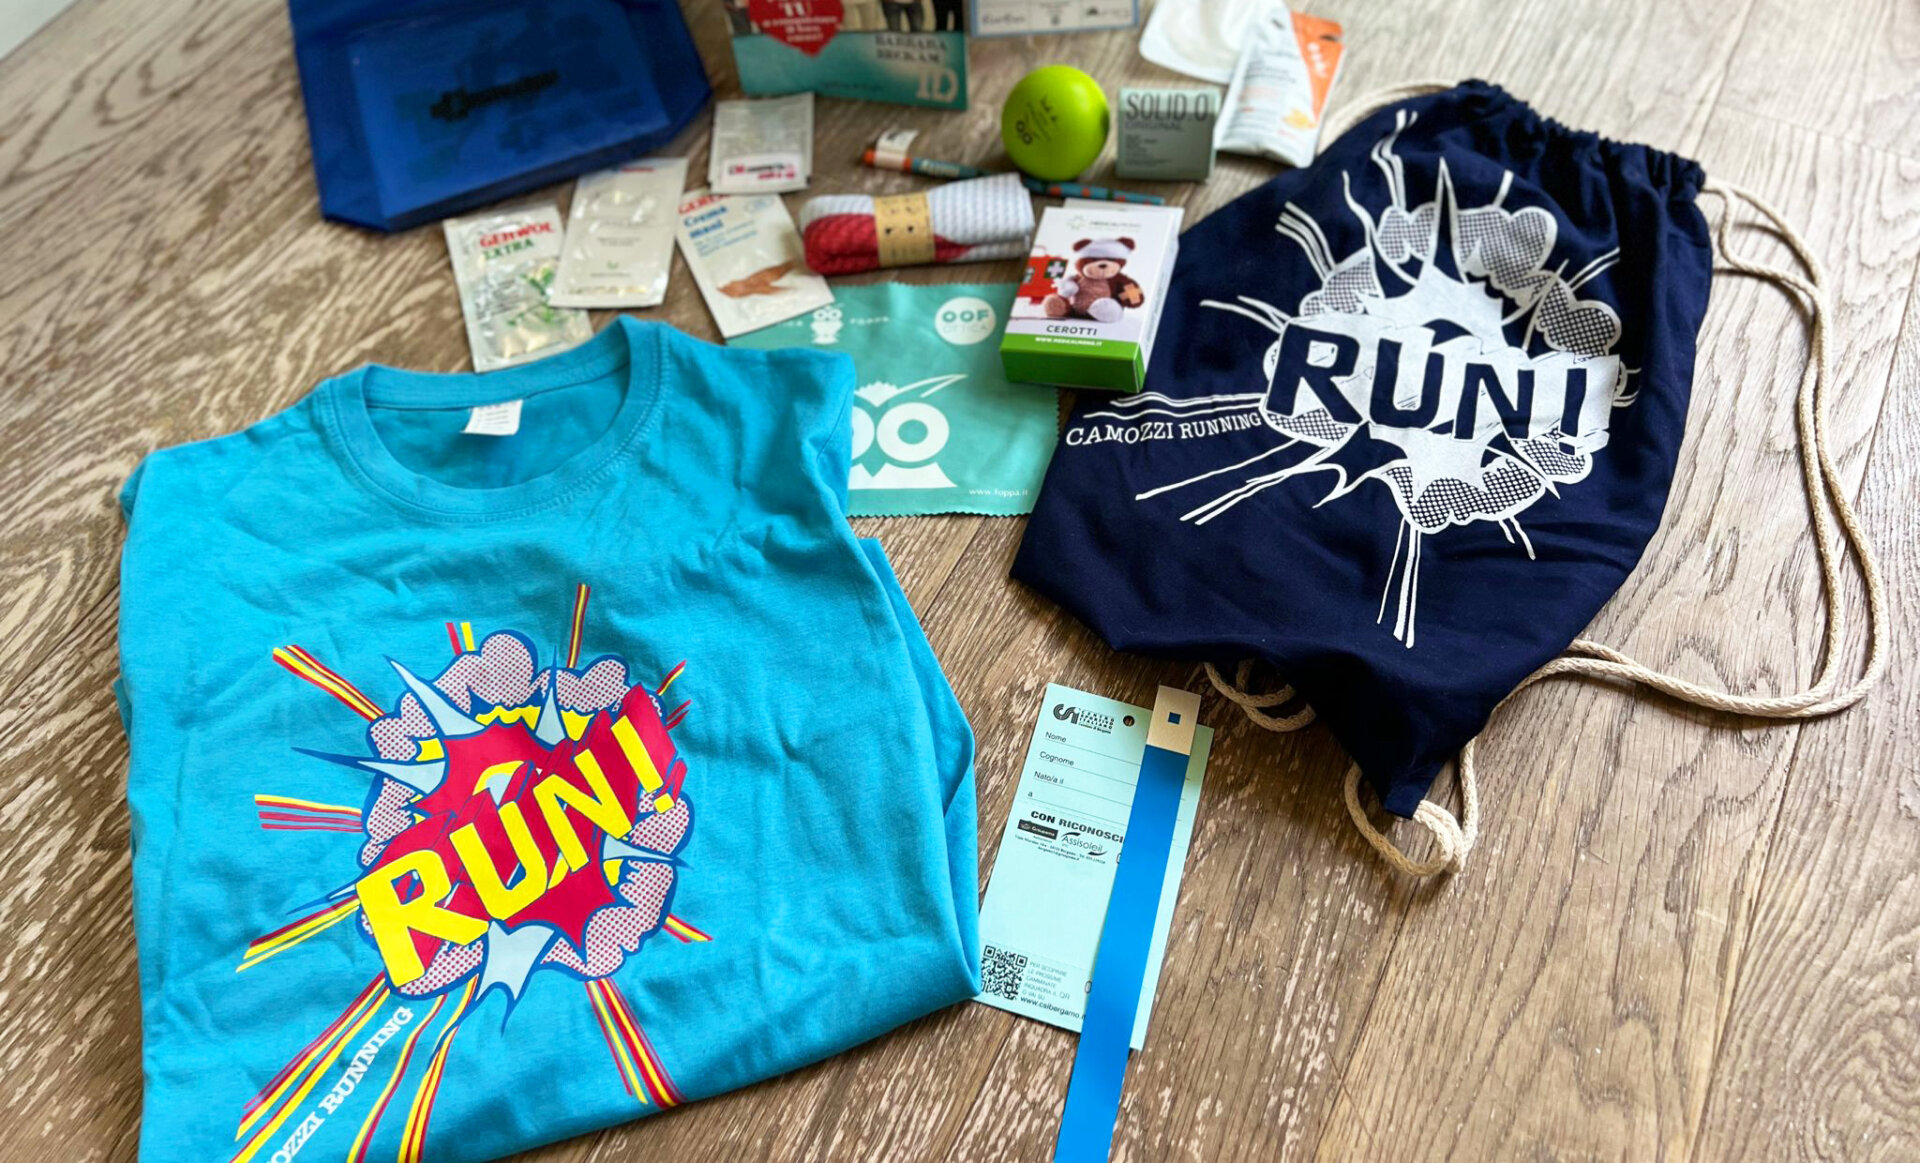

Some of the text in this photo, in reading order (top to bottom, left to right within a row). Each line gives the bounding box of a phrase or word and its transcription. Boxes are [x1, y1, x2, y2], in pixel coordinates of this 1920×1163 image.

[942, 309, 990, 324] OOF
[1046, 324, 1098, 336] CEROTTI
[1266, 321, 1589, 456] RUN!
[1066, 412, 1262, 446] CAMOZZI RUNNING
[1045, 731, 1067, 743] Nome
[1039, 750, 1075, 767] Cognome
[1034, 770, 1058, 784] Nato/a
[1030, 810, 1056, 824] CON
[1058, 818, 1125, 844] RICONOSCI
[355, 714, 676, 988] RUN!
[318, 1005, 414, 1115] RUNNING
